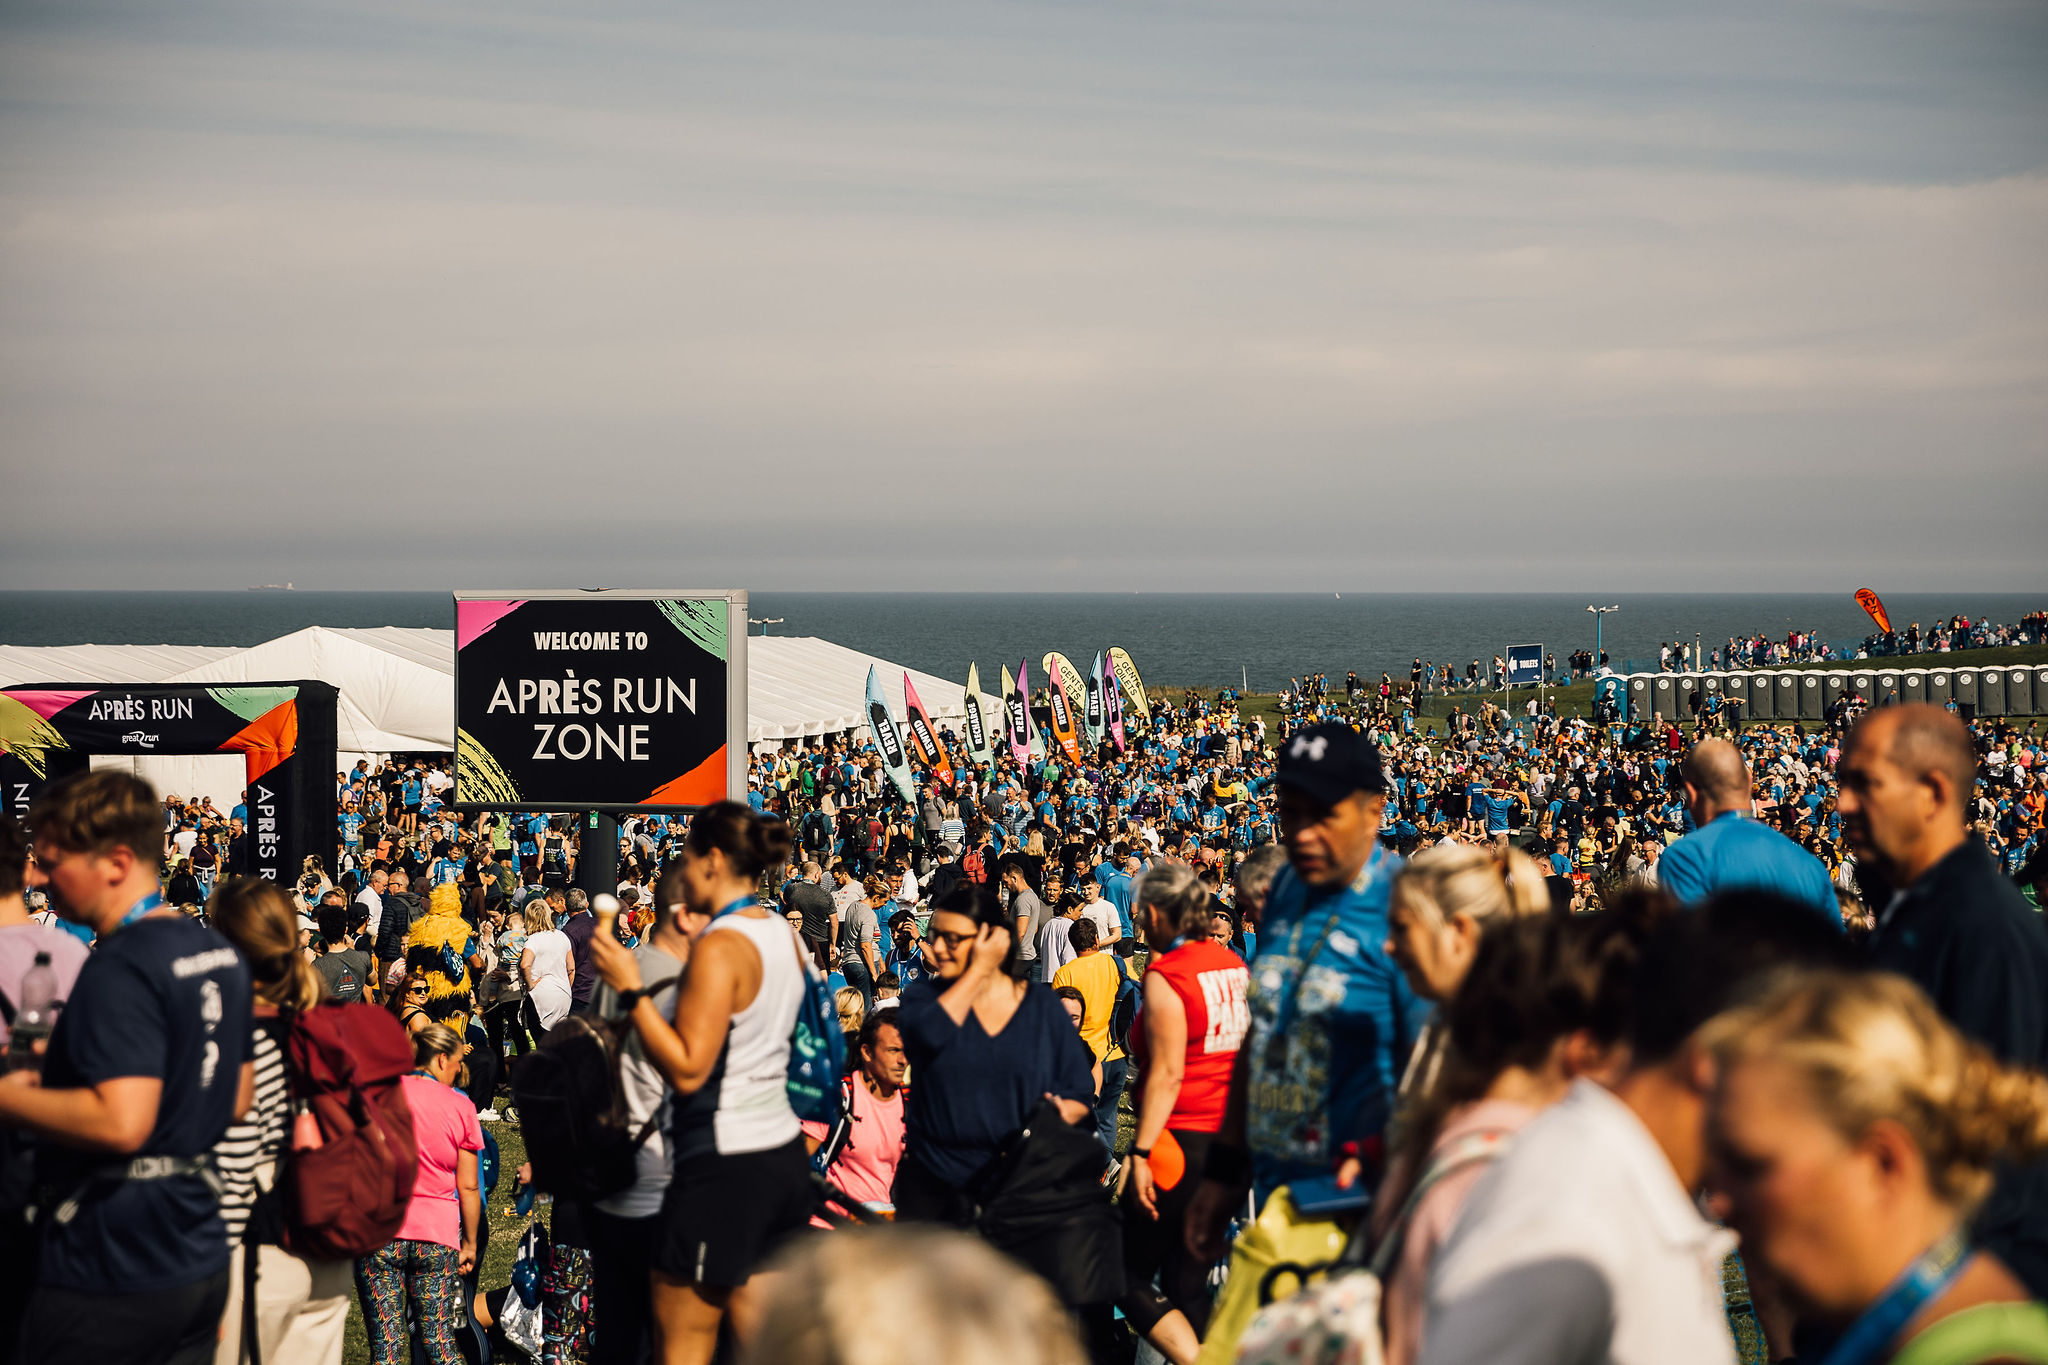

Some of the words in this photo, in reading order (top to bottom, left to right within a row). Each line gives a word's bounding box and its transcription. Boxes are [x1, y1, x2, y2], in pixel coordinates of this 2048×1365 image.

[534, 631, 620, 651] WELCOME
[625, 631, 648, 651] TO
[1061, 666, 1085, 692] GENTS
[1113, 663, 1138, 696] TOILETS
[1121, 661, 1142, 688] GENTS
[88, 694, 146, 720] APRÈS
[151, 698, 193, 720] RUN
[486, 669, 602, 716] APRÈS
[614, 677, 696, 715] RUN
[1089, 690, 1100, 716] REVEL
[1108, 686, 1117, 713] RELAX
[967, 702, 983, 745] RECHARGE
[1014, 701, 1025, 733] RELAX
[1053, 694, 1068, 726] REWIND
[532, 723, 650, 762] ZONE
[878, 718, 899, 755] REVEL
[913, 719, 937, 757] REWIND
[257, 784, 281, 858] APRÈS
